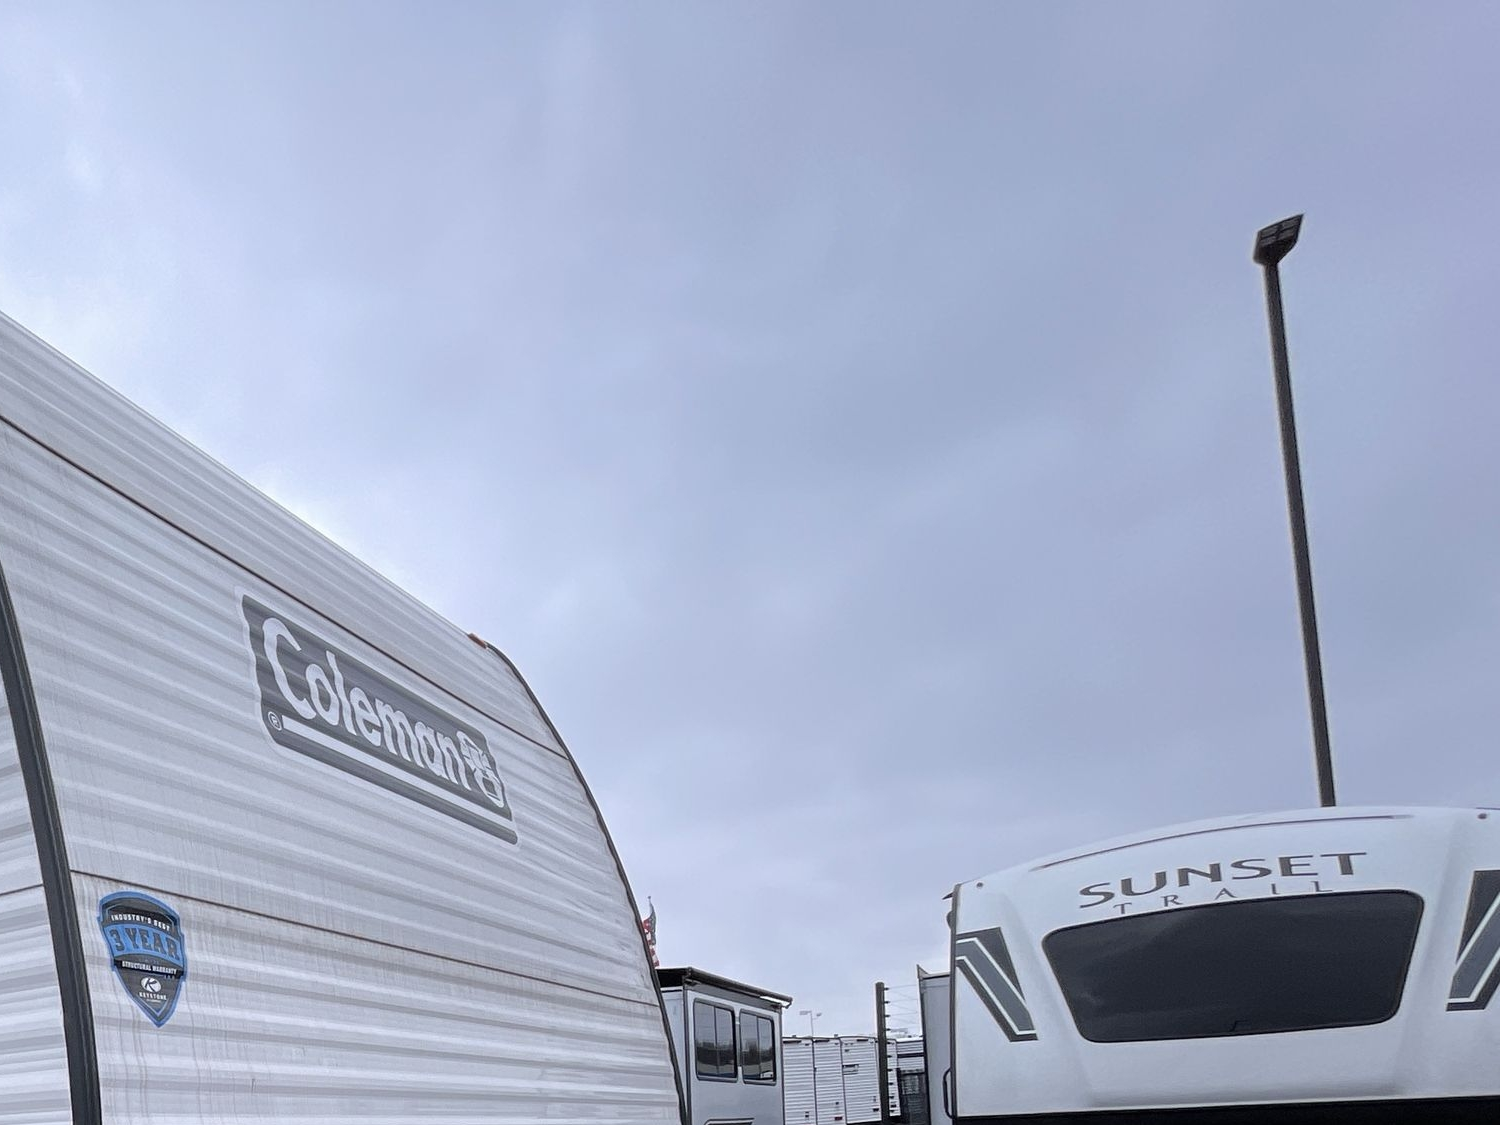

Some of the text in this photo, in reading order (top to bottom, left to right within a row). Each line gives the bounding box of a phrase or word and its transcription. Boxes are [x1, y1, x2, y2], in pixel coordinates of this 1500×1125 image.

[262, 617, 471, 791] Coleman
[1079, 852, 1367, 908] SUNSET
[1113, 880, 1333, 915] TRAIL
[111, 914, 171, 931] INDUSTRY'S BEST
[110, 927, 181, 961] 3 YEAR
[122, 960, 151, 972] STRUCTURAL
[153, 964, 177, 975] WARRANTY
[139, 991, 167, 1001] KEYSTONE
